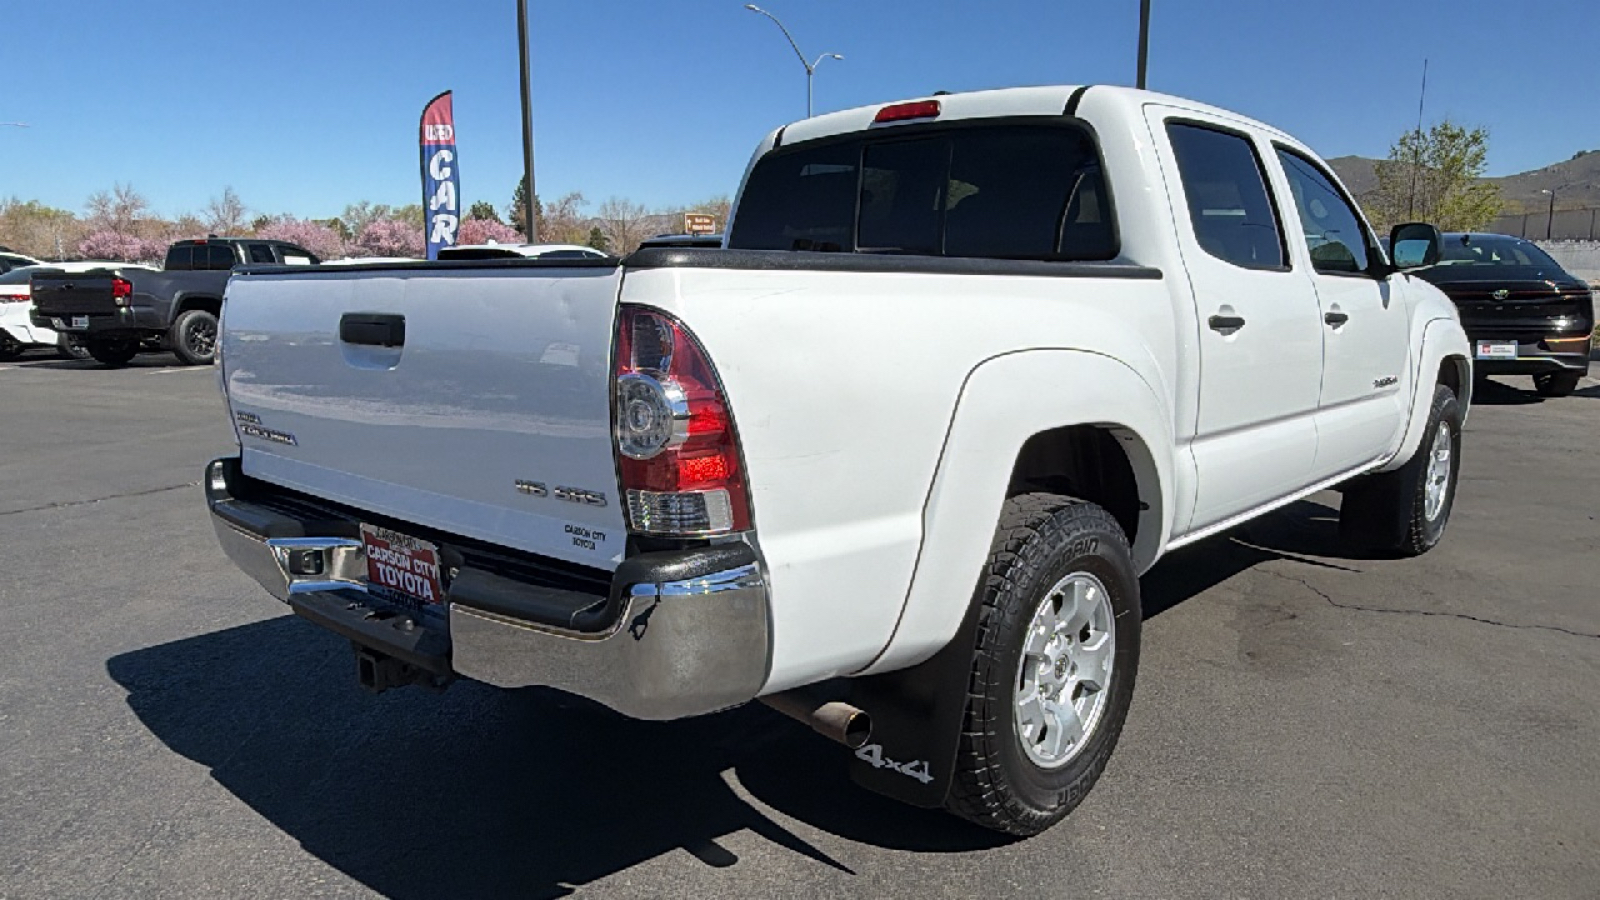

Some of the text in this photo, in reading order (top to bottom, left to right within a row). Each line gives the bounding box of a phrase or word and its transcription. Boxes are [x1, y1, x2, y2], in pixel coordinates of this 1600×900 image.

[425, 124, 453, 141] USED
[429, 149, 458, 246] CAR
[564, 524, 607, 542] CARSON CITY
[572, 537, 596, 551] TOYOTA
[367, 544, 436, 580] CARSON CITY
[376, 562, 435, 601] TOYOTA
[854, 743, 934, 785] 4x4
